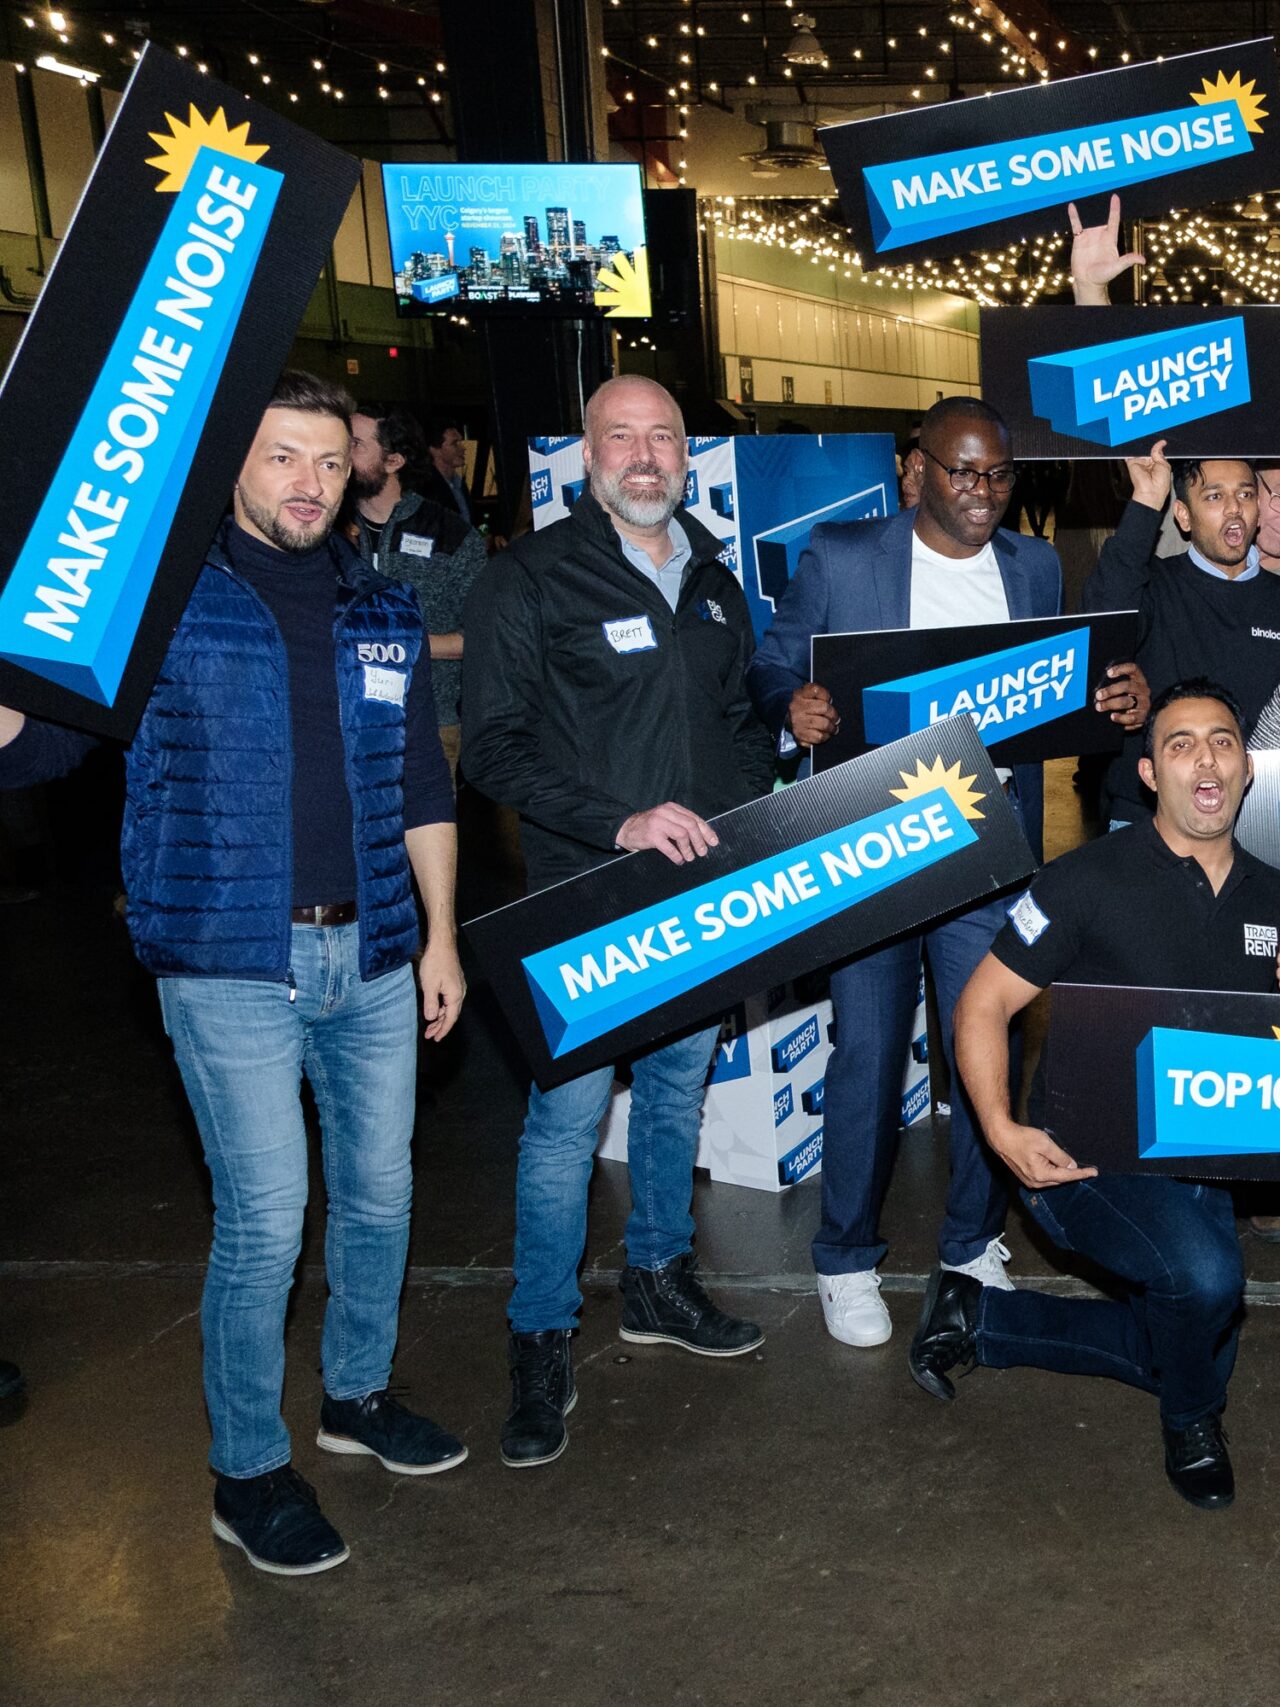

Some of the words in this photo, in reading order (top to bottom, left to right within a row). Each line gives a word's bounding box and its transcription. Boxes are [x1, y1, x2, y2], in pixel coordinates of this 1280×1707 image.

[892, 160, 1002, 211] MAKE
[1010, 138, 1115, 187] SOME
[1121, 112, 1235, 165] NOISE
[401, 176, 514, 201] LAUNCH
[522, 176, 611, 201] PARTY
[402, 205, 459, 230] YYC
[1093, 337, 1233, 404] LAUNCH
[23, 481, 129, 643] MAKE
[92, 325, 193, 485] SOME
[155, 164, 259, 332] NOISE
[1123, 363, 1233, 422] PARTY
[357, 643, 406, 663] 500
[611, 627, 642, 643] BRETT
[929, 648, 1075, 726] LAUNCH
[559, 916, 692, 1001] MAKE
[694, 861, 821, 941] SOME
[820, 802, 954, 886] NOISE
[1245, 939, 1278, 958] RENT
[1246, 926, 1276, 940] TRACE
[782, 1021, 816, 1060] LAUNCH
[789, 1029, 817, 1062] PARTY
[1167, 1069, 1253, 1108] TOP
[789, 1132, 824, 1172] LAUNCH
